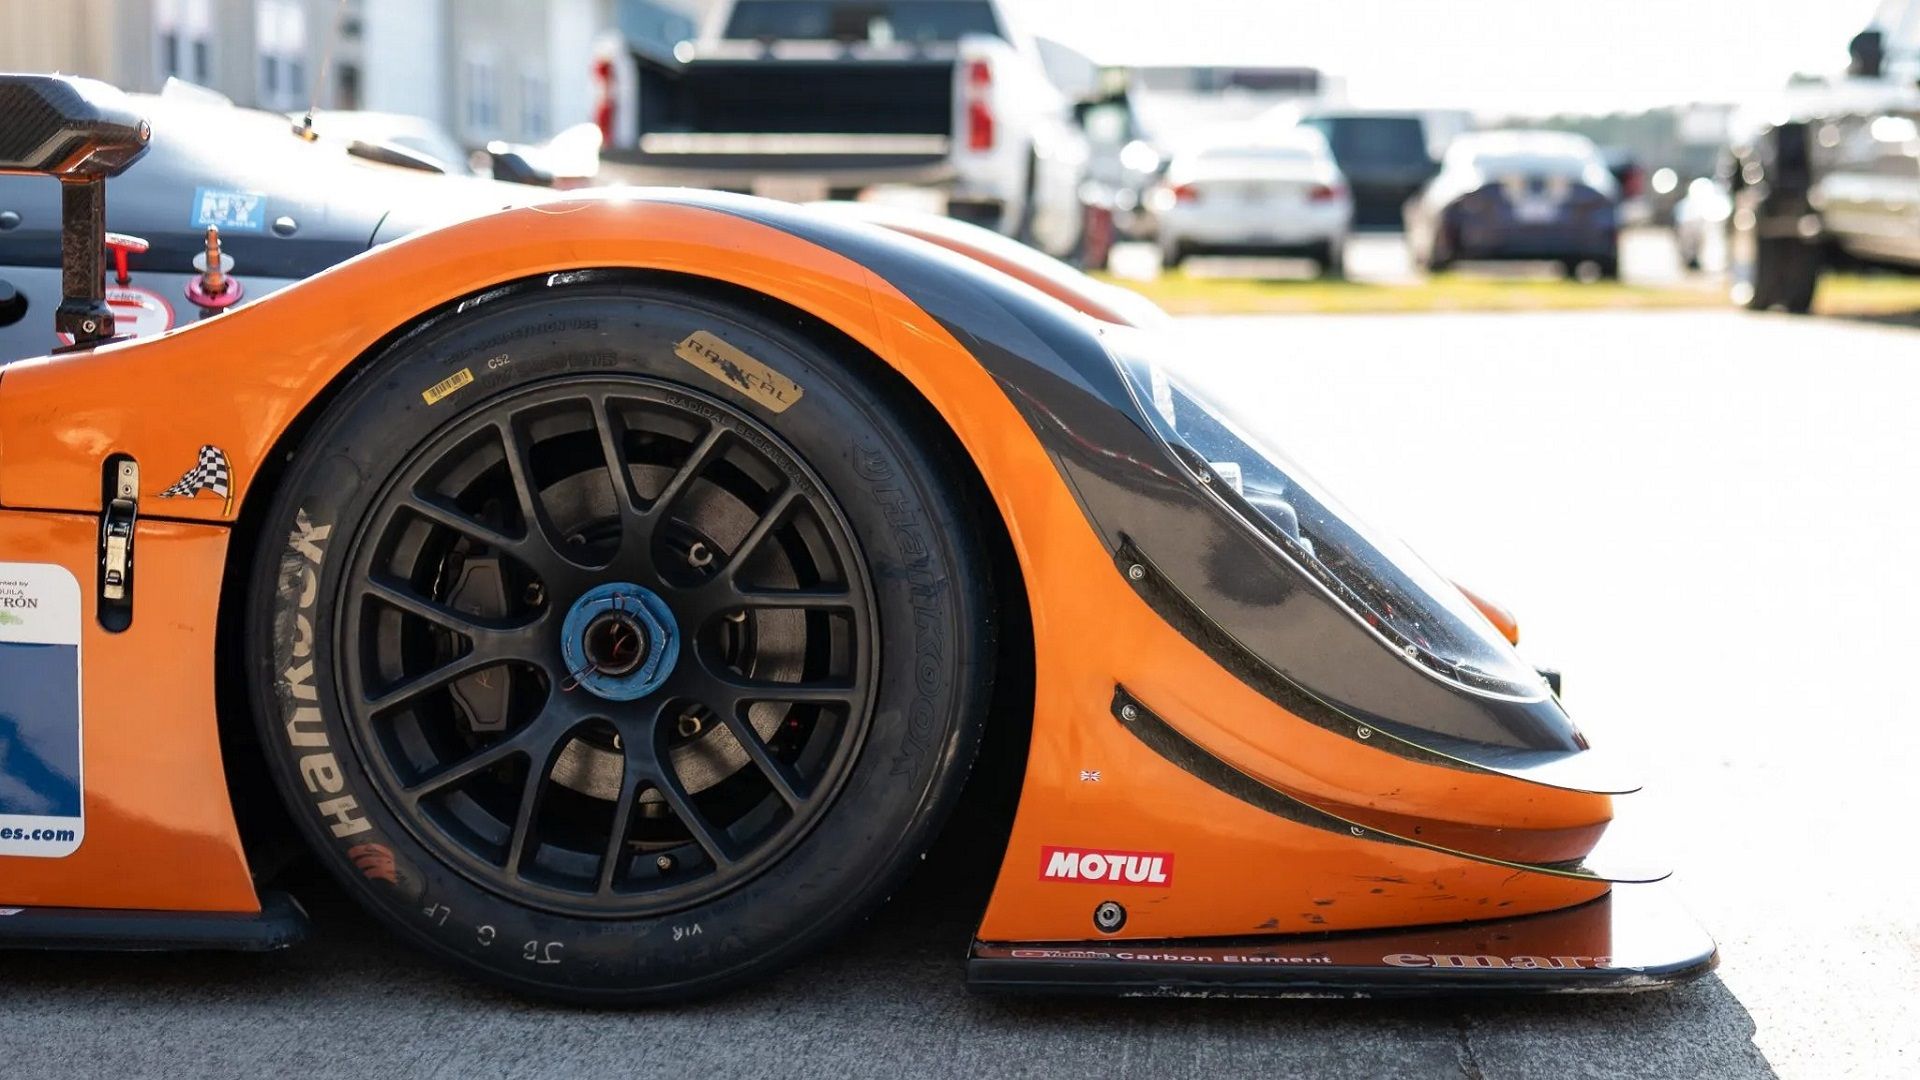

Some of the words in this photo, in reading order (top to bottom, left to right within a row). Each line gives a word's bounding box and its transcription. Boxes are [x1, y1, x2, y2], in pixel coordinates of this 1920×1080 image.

[487, 353, 511, 370] C52
[687, 339, 788, 404] RACAL
[0, 595, 39, 608] RÓN
[0, 828, 75, 842] es.com
[1045, 851, 1167, 883] MOTUL
[1116, 952, 1214, 962] Carbon
[1223, 954, 1333, 964] Element
